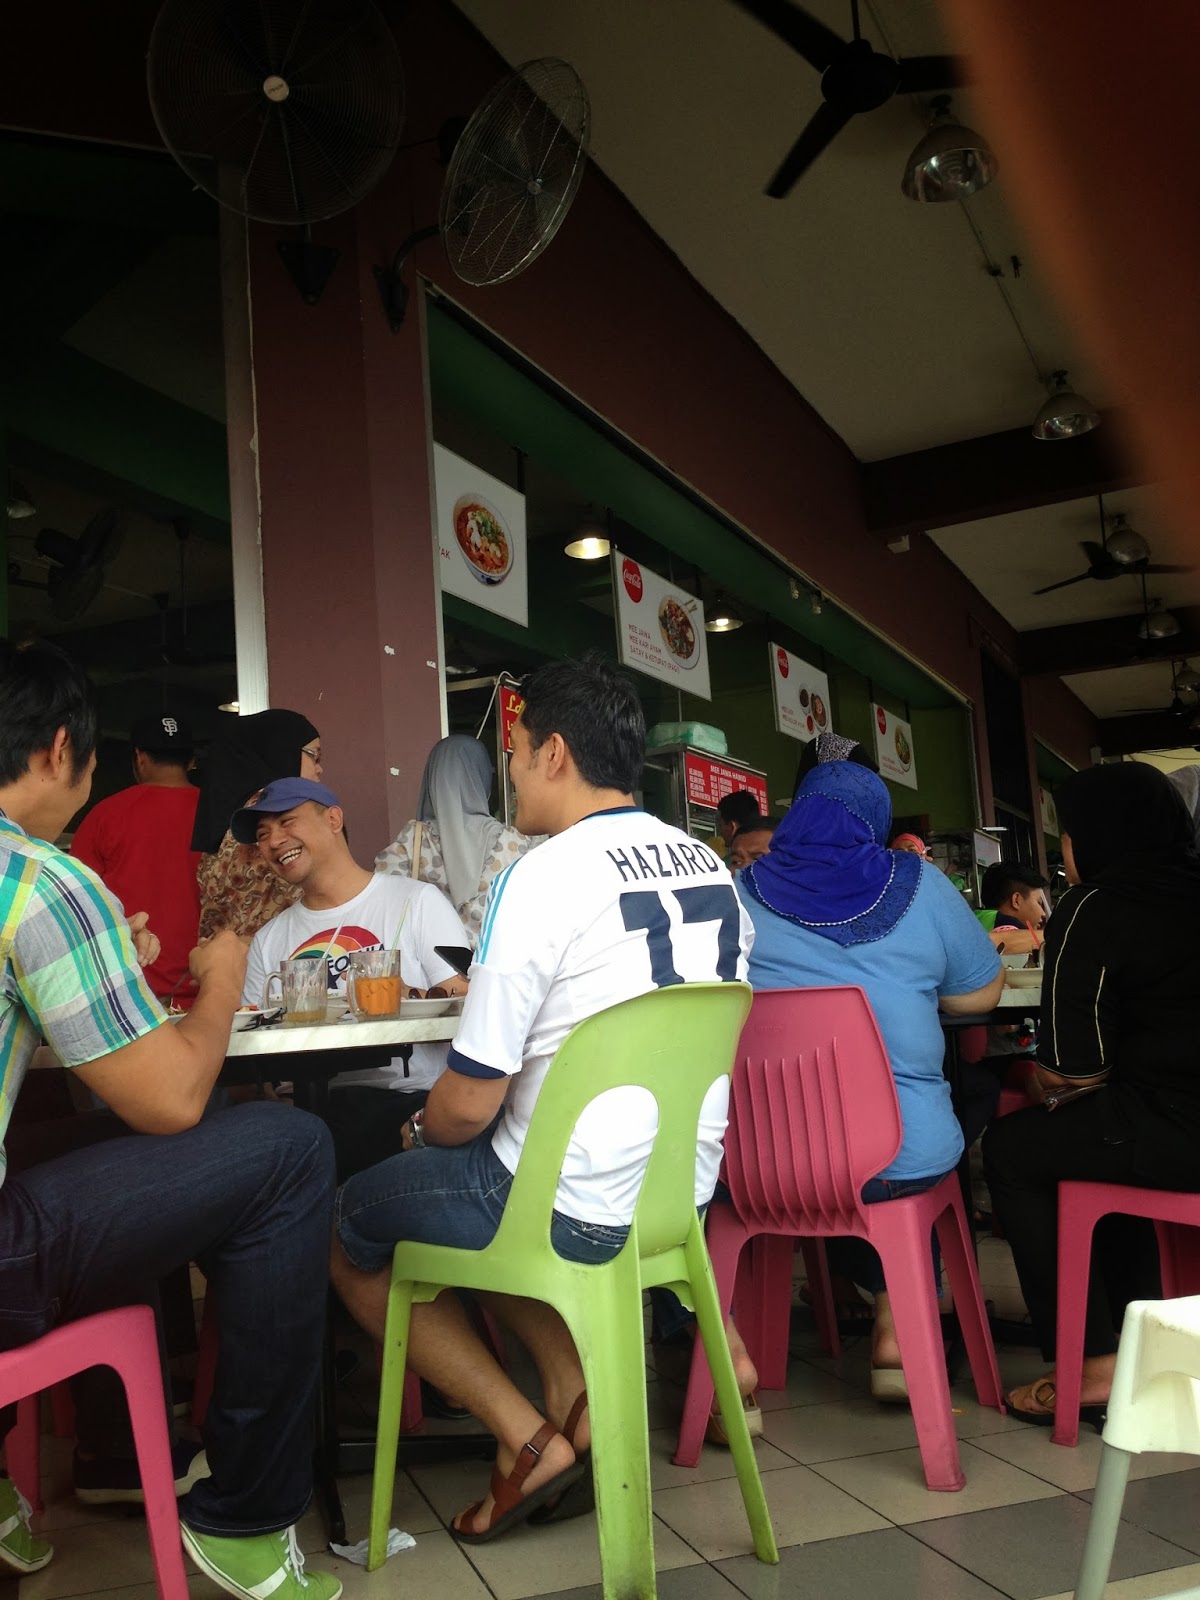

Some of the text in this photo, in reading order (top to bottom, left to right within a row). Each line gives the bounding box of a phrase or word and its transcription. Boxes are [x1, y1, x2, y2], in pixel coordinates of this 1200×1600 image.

[628, 623, 651, 639] MEE JAWA
[629, 634, 639, 645] MEE
[710, 764, 720, 774] MEE
[606, 843, 719, 882] HAZARD
[619, 884, 742, 988] 17
